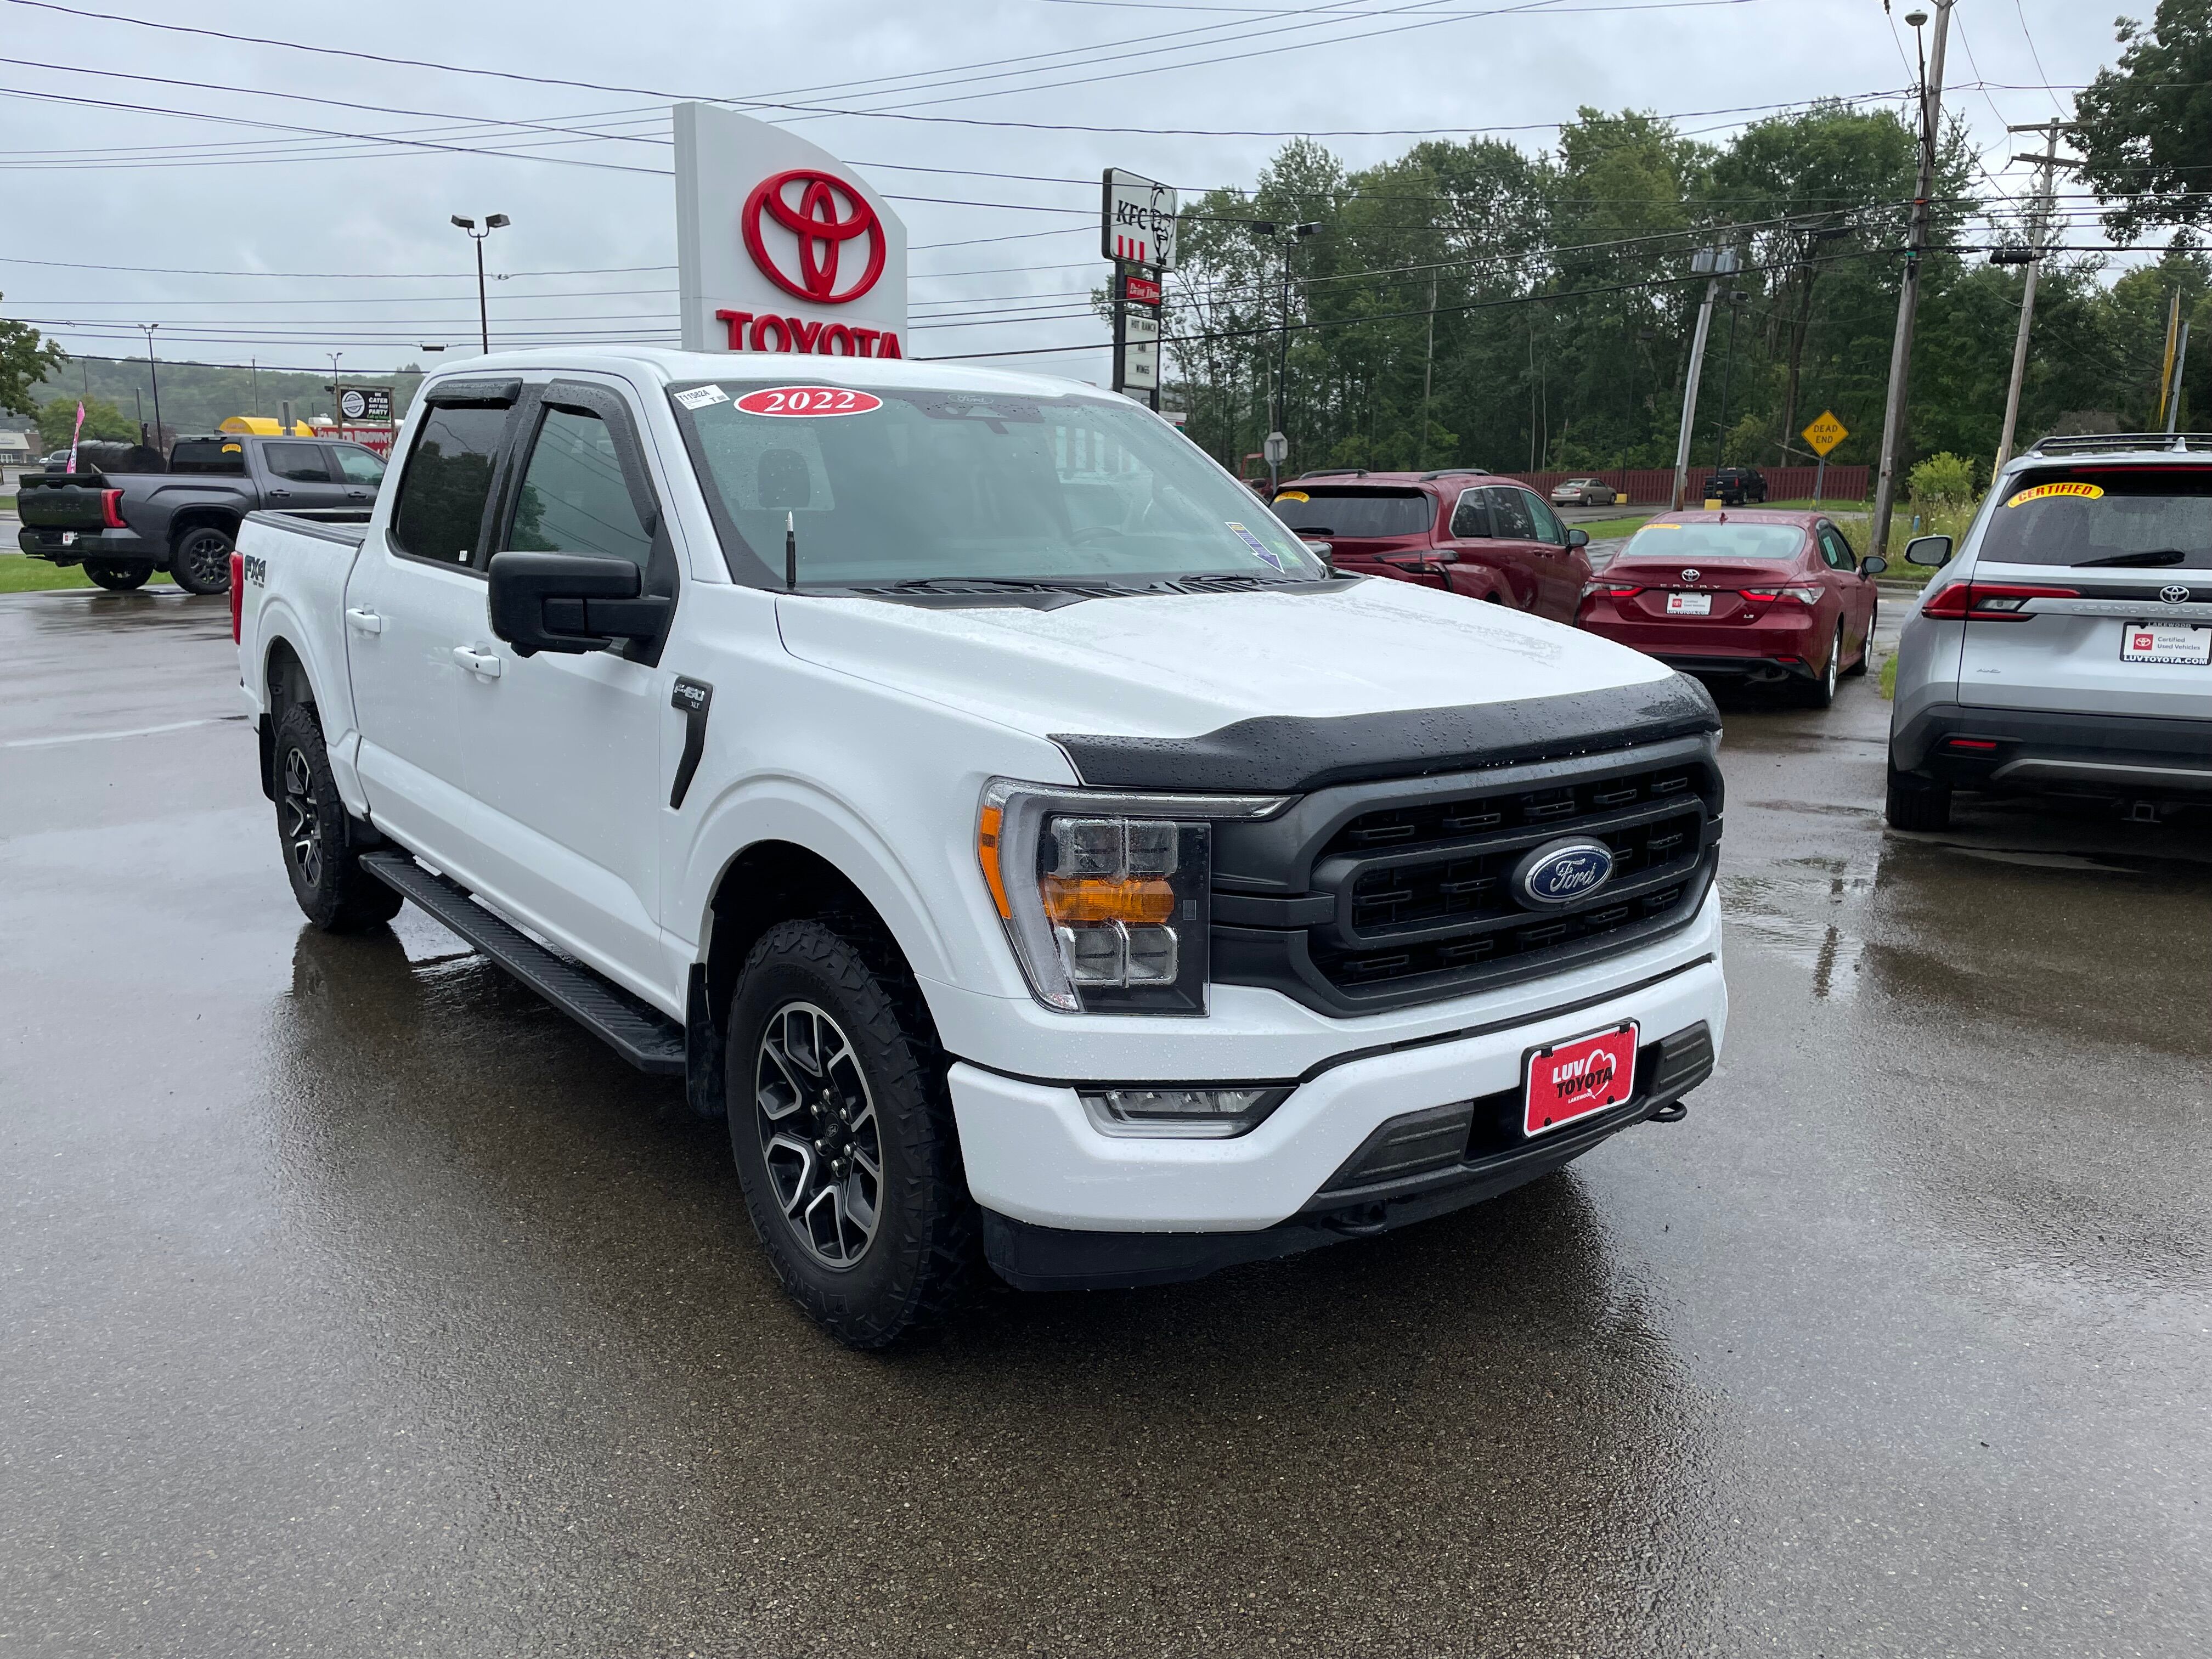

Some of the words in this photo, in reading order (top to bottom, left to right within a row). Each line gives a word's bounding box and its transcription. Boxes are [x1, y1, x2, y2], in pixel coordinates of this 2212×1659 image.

[1116, 199, 1147, 229] KFC
[716, 309, 902, 360] TOYOTA
[678, 390, 710, 402] T11582A
[764, 392, 855, 411] 2022
[2018, 484, 2093, 501] CERTIFIED
[244, 555, 266, 583] FX4
[2072, 605, 2140, 613] GRAND
[2123, 654, 2208, 665] LUVTOYOTA.COM
[691, 701, 700, 709] XLT
[1550, 858, 1597, 893] Ford
[1553, 1058, 1585, 1084] LUV
[1556, 1067, 1613, 1098] TOYOTA
[1567, 1091, 1594, 1104] LAKEWOOD
